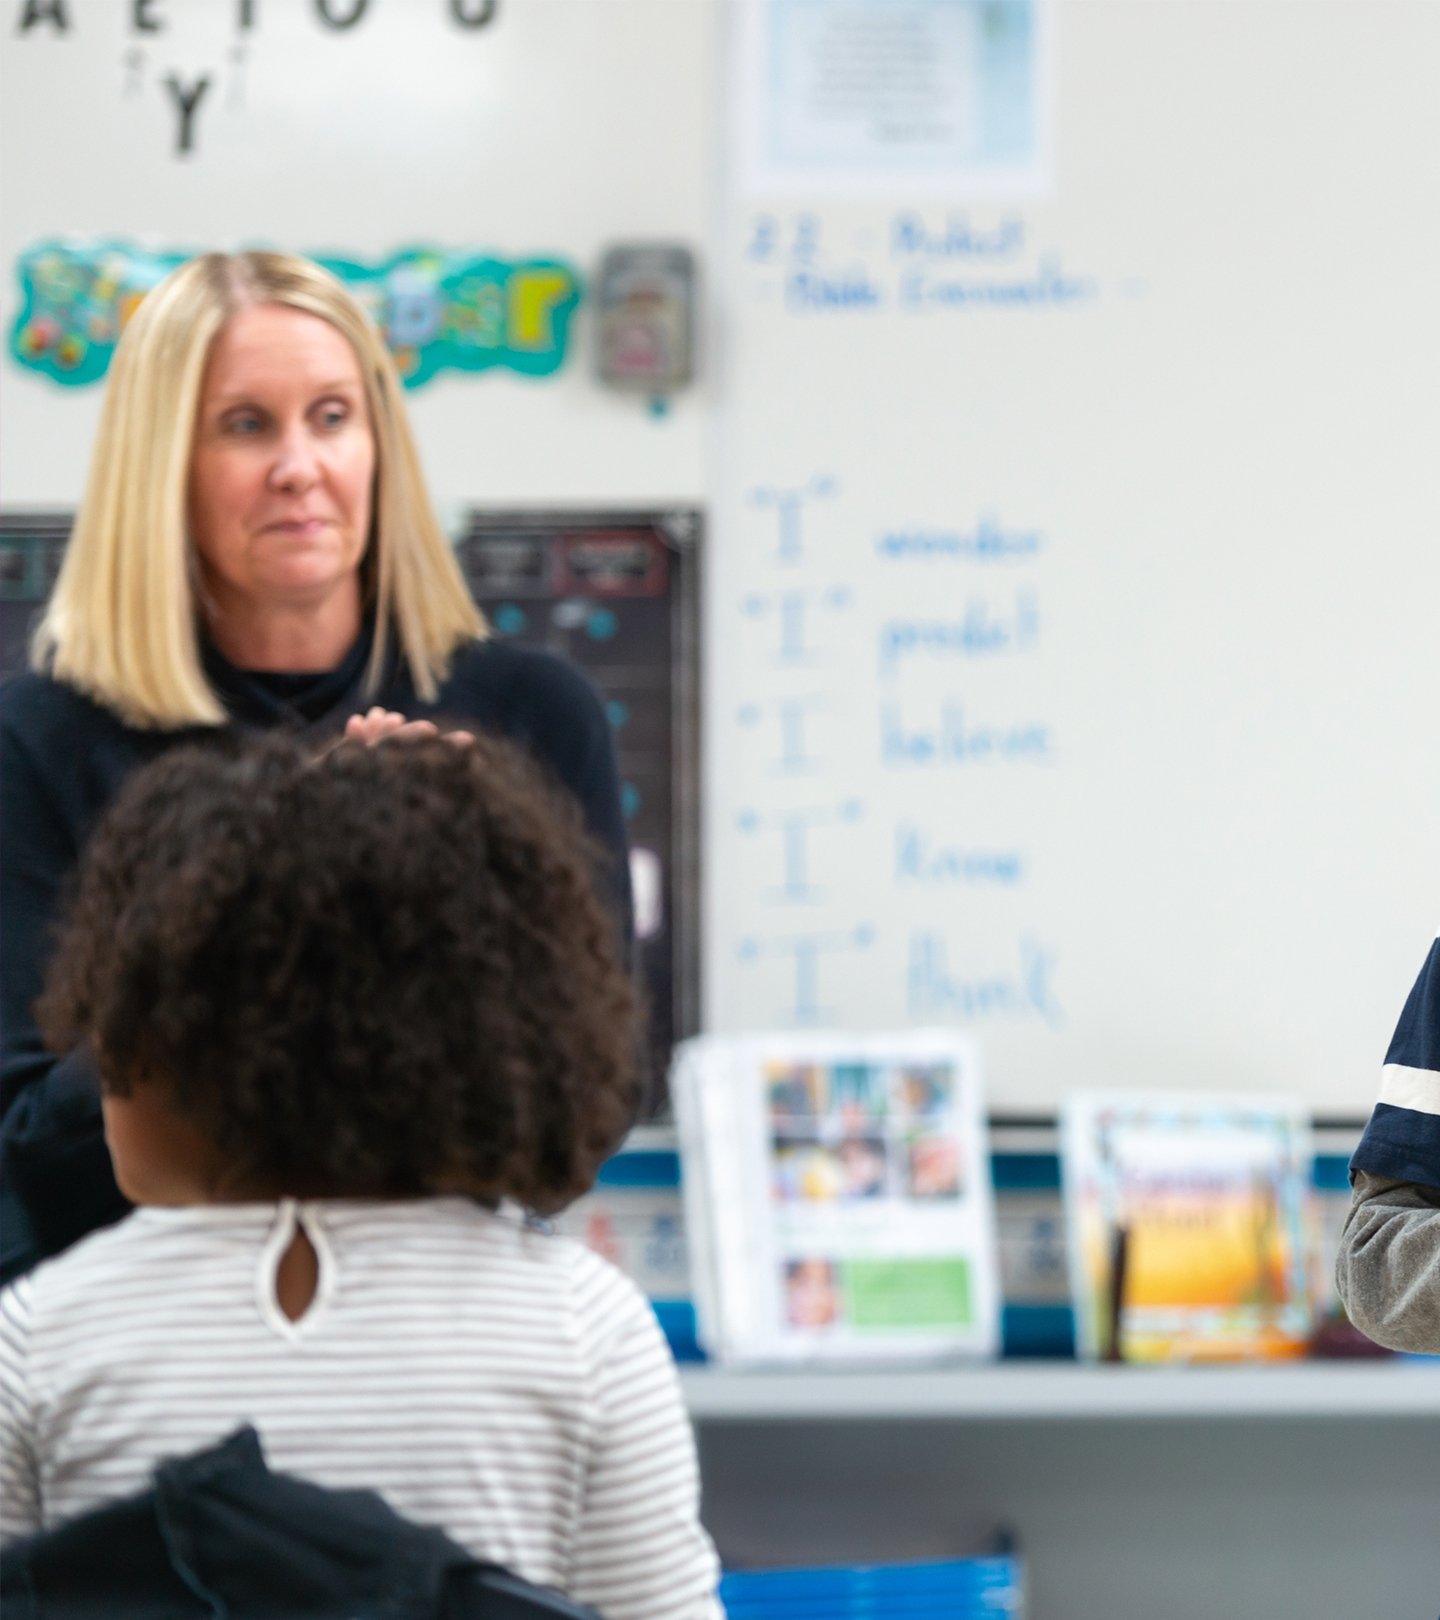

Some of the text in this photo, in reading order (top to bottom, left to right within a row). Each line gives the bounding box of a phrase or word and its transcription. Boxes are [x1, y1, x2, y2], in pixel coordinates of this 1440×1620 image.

[164, 70, 209, 156] Y
[876, 513, 1040, 562] wonder
[880, 598, 1038, 676] predict
[882, 704, 1050, 765] believe
